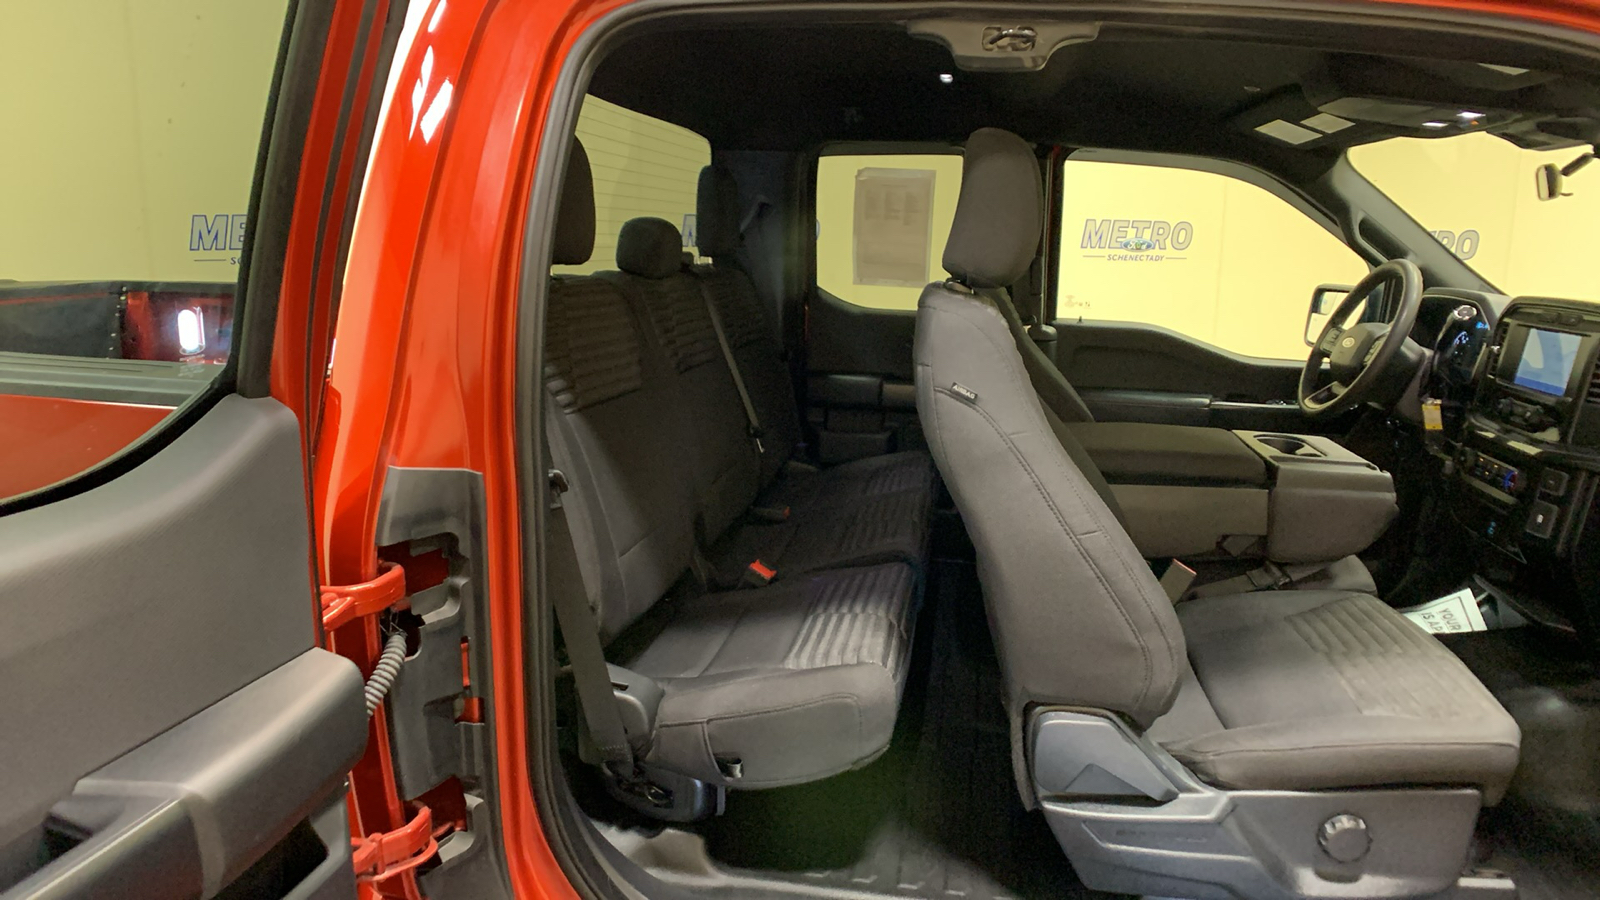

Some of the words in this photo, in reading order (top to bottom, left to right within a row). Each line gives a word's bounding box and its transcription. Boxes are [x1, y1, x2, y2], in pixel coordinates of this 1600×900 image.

[1080, 219, 1194, 251] METRO
[1107, 254, 1165, 262] SCHENECTADY
[1438, 607, 1462, 631] YOUR
